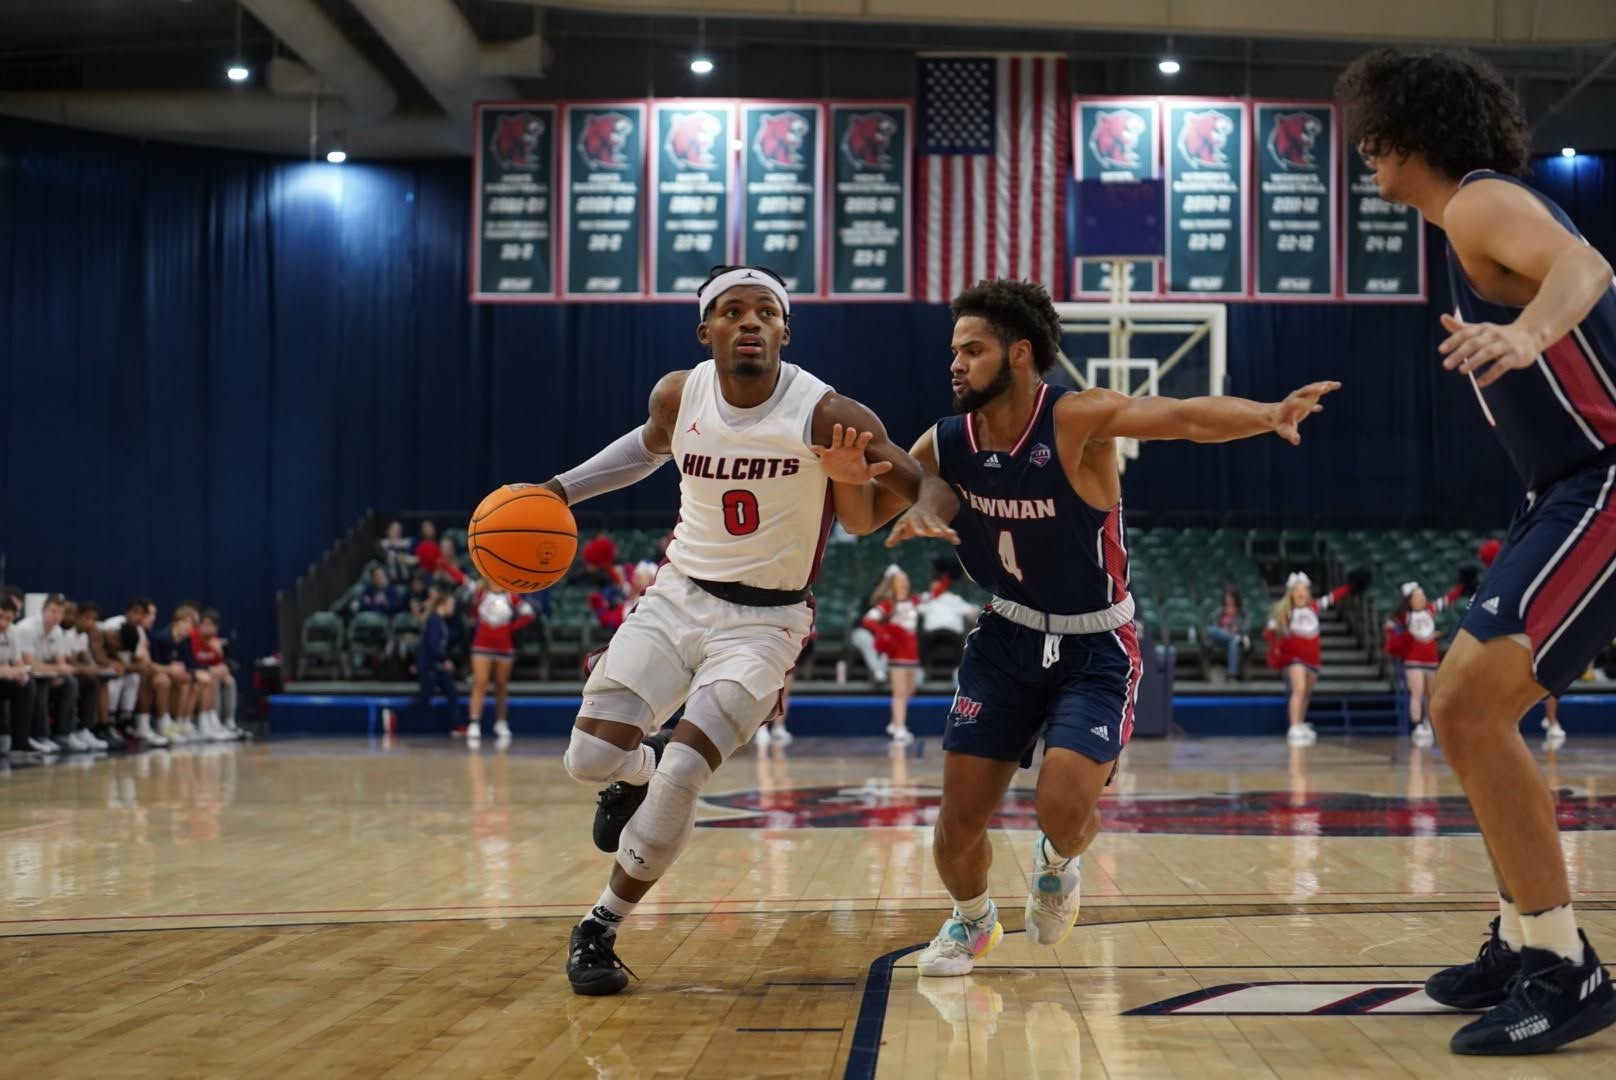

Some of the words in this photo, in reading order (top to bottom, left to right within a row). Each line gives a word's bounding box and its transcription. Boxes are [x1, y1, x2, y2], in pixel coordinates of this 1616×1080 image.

[682, 453, 800, 480] HILLCATS
[722, 489, 760, 536] 0
[998, 530, 1023, 583] 4
